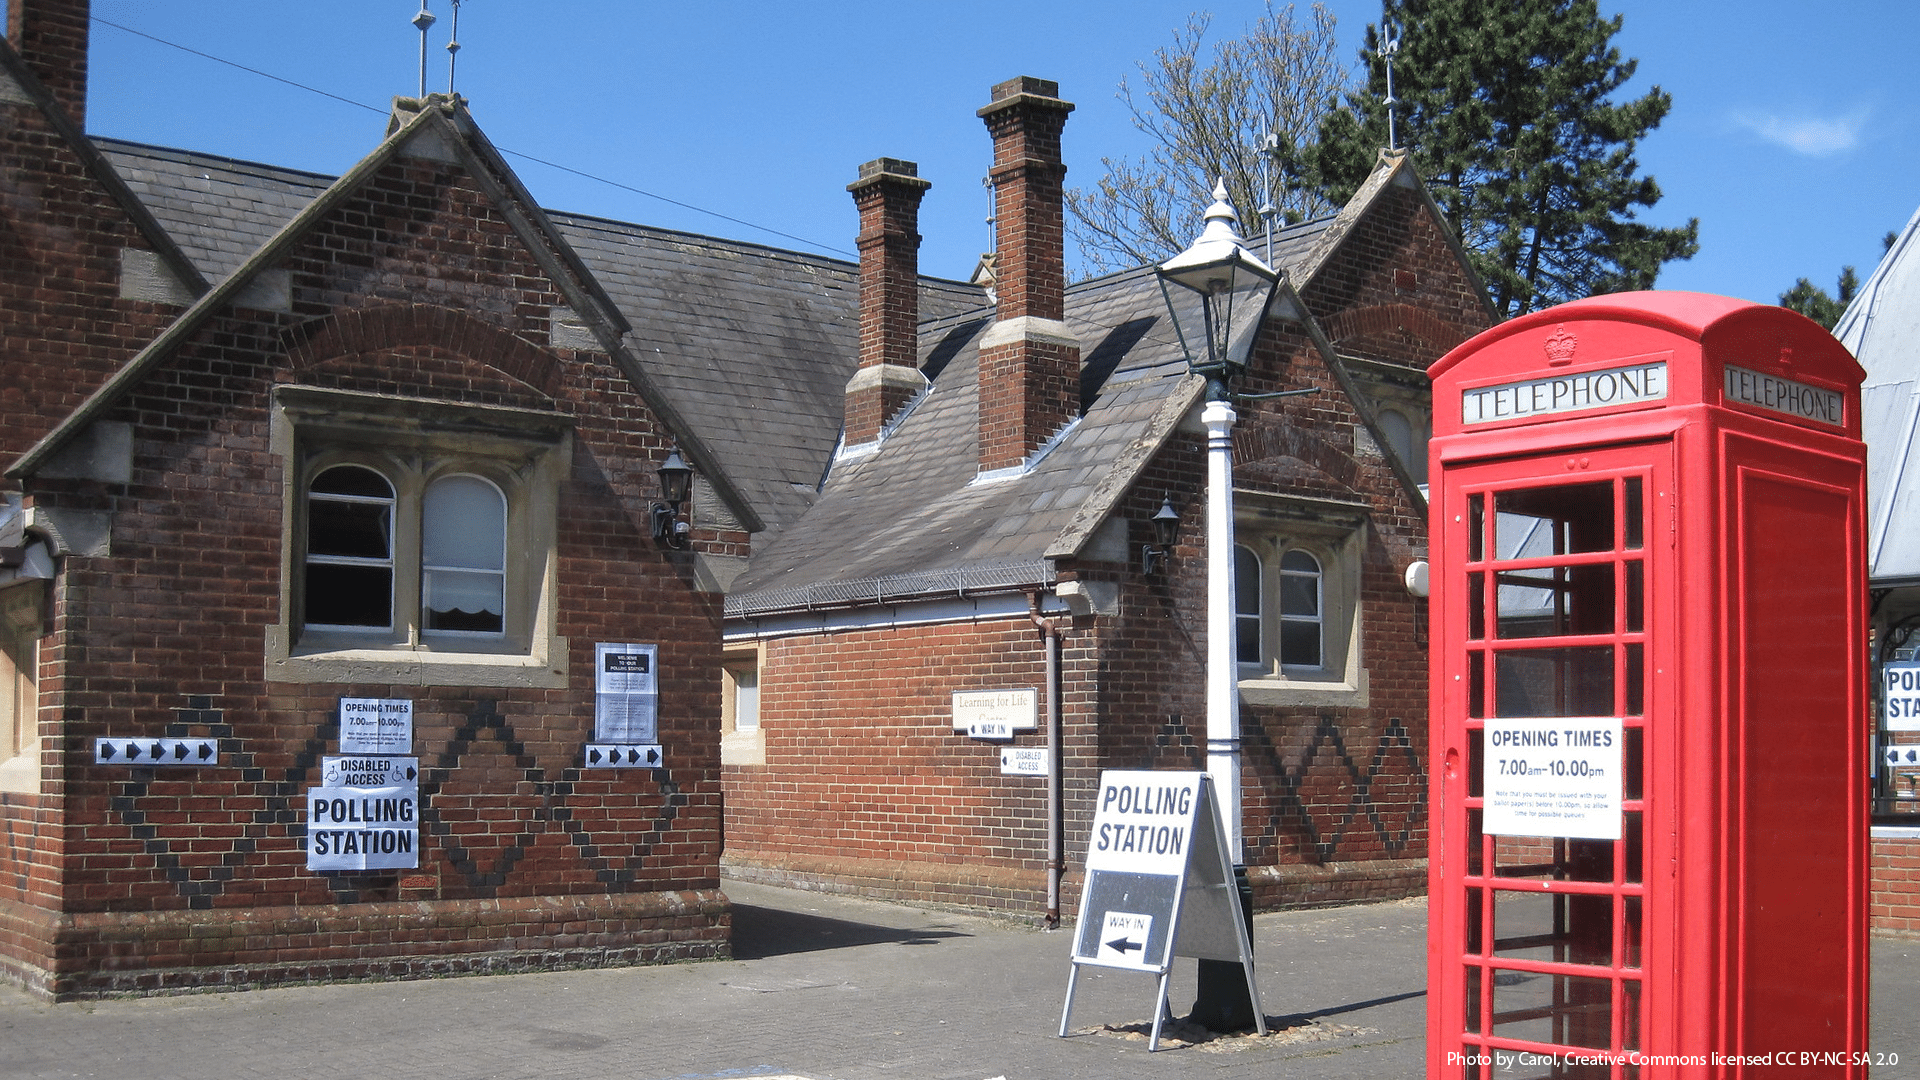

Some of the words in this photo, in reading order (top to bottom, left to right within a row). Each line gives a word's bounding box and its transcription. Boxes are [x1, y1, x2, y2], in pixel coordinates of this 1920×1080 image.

[1472, 367, 1661, 420] TELEPHONE
[1725, 367, 1838, 423] TELEPHONE
[959, 695, 995, 709] Learning
[997, 694, 1009, 707] for
[1011, 693, 1028, 706] Life
[345, 703, 383, 713] OPENING
[385, 704, 409, 713] TIMES
[981, 724, 995, 735] WAY
[997, 724, 1006, 735] IN
[1492, 729, 1559, 748] OPENING
[1564, 730, 1612, 748] TIMES
[1016, 751, 1042, 761] DISABLED
[340, 760, 391, 772] DISABLED
[1018, 761, 1039, 771] ACCESS
[345, 773, 385, 785] ACCESS
[1103, 785, 1191, 816] POLLING
[1522, 791, 1533, 799] you
[1558, 791, 1578, 799] issued
[314, 798, 413, 823] POLLING
[1535, 800, 1553, 808] before
[1538, 811, 1561, 819] possible
[315, 830, 411, 855] STATION
[1097, 822, 1184, 855] STATION
[1109, 916, 1131, 928] WAY
[1133, 918, 1145, 930] IN
